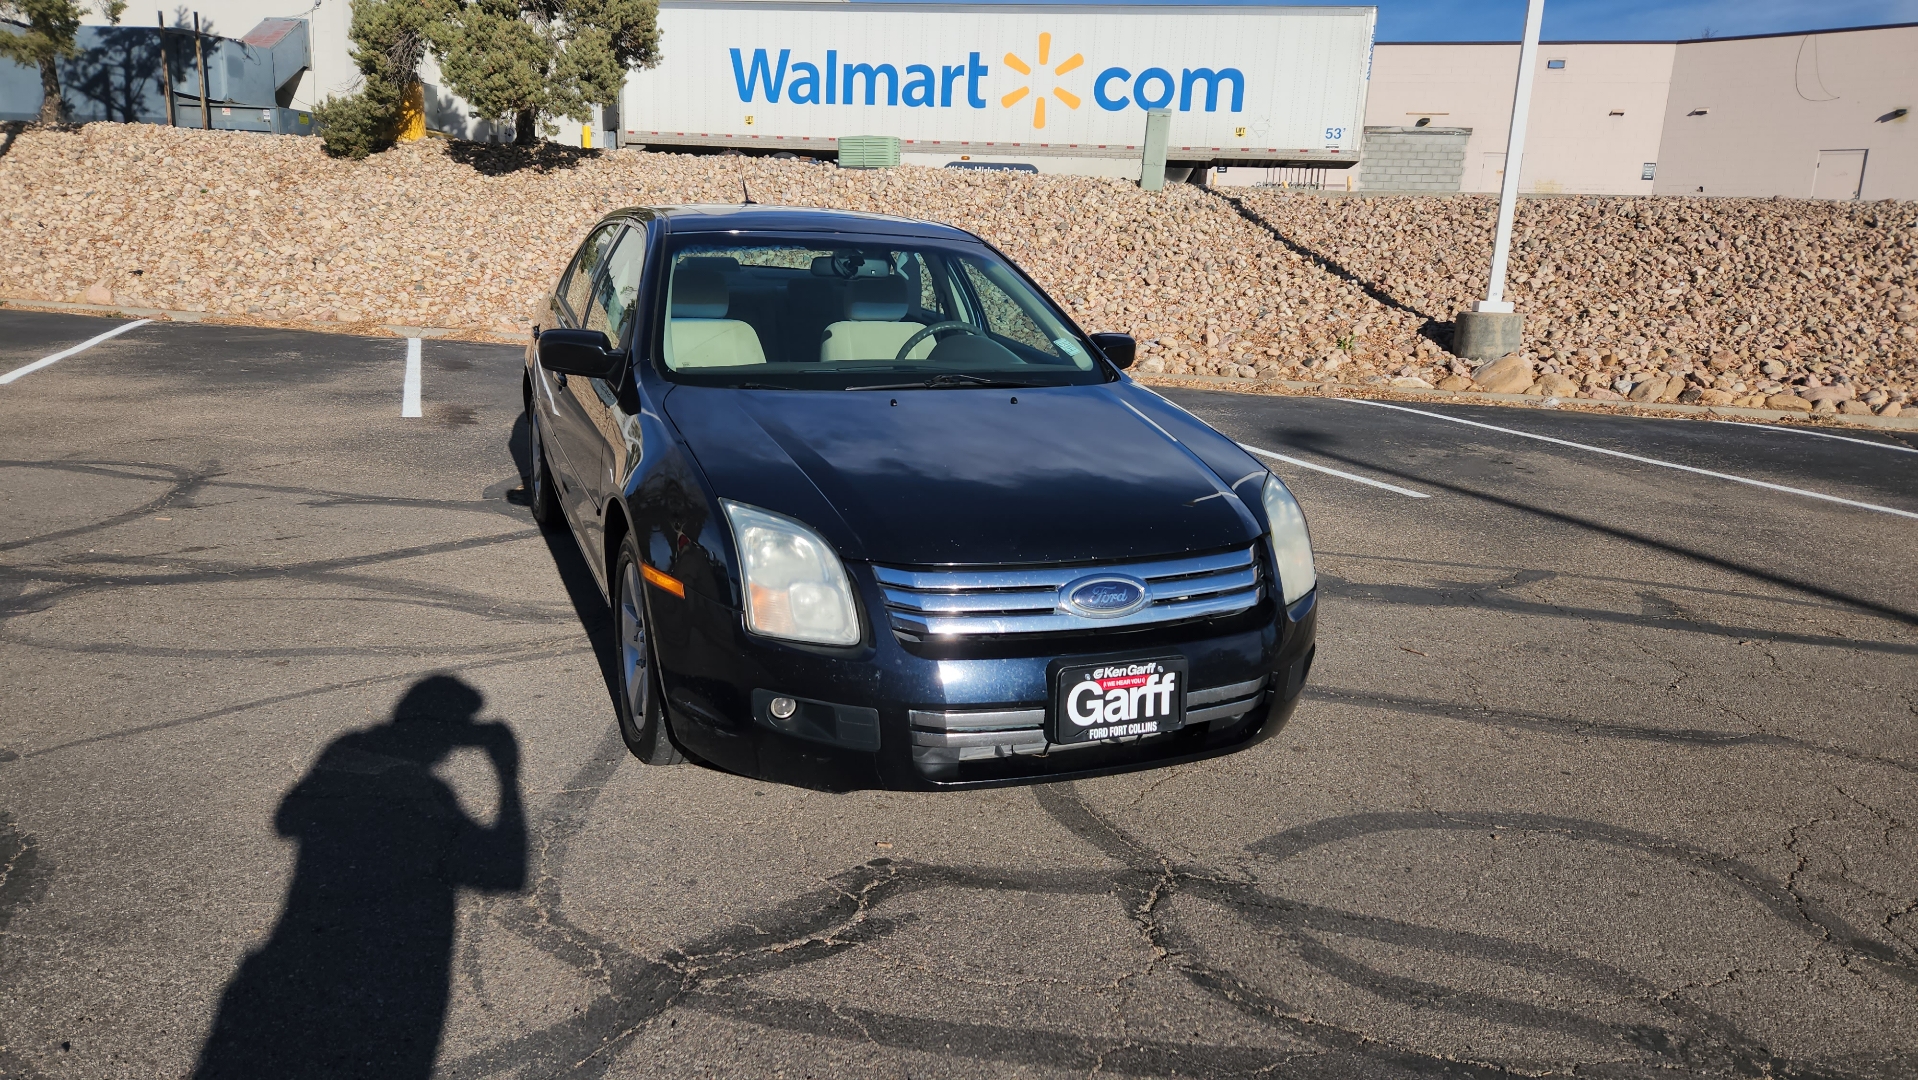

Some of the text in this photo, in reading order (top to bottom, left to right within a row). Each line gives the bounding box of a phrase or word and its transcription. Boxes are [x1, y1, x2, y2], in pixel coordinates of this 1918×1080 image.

[729, 48, 1245, 112] Walmart com
[1091, 585, 1128, 605] Ford
[1103, 667, 1127, 678] Ken
[1127, 663, 1156, 675] Garff
[1067, 673, 1175, 726] Garff
[1089, 721, 1158, 739] FORD FORT COLLINS
